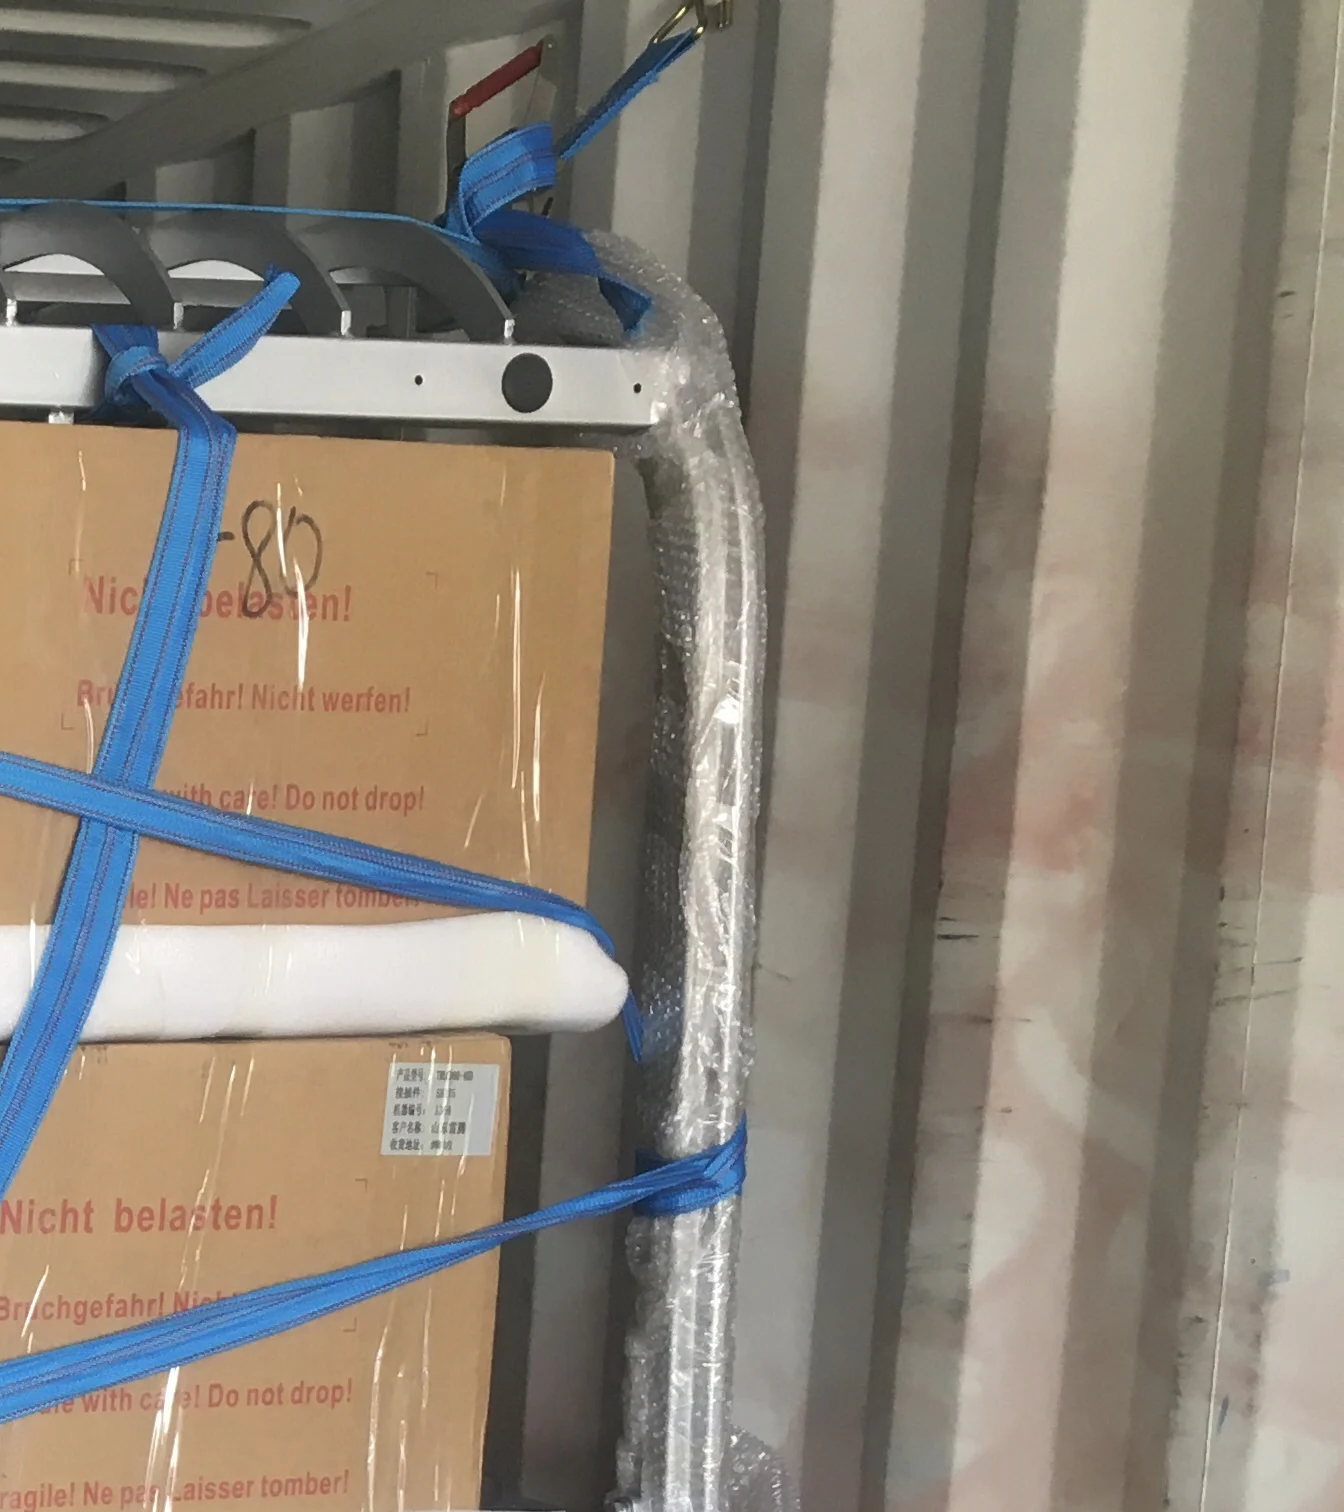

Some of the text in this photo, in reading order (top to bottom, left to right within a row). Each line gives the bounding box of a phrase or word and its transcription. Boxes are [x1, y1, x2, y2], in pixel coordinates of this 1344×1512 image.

[83, 575, 147, 615] Nic
[252, 683, 315, 712] Nicht
[322, 686, 410, 714] werfen!
[163, 783, 212, 807] ith
[286, 784, 311, 811] Do
[324, 785, 359, 811] not
[364, 785, 425, 816] drop!
[164, 882, 193, 909] Ne
[199, 886, 239, 914] pas
[247, 883, 328, 909] Laisser
[0, 1195, 278, 1235] Nicht belasten!
[83, 1386, 132, 1413] with
[140, 1384, 200, 1410] cae!
[207, 1382, 239, 1408] Do
[247, 1384, 285, 1406] not
[290, 1379, 353, 1408] drop!
[83, 1481, 114, 1507] Ne
[260, 1469, 350, 1499] tomber!
